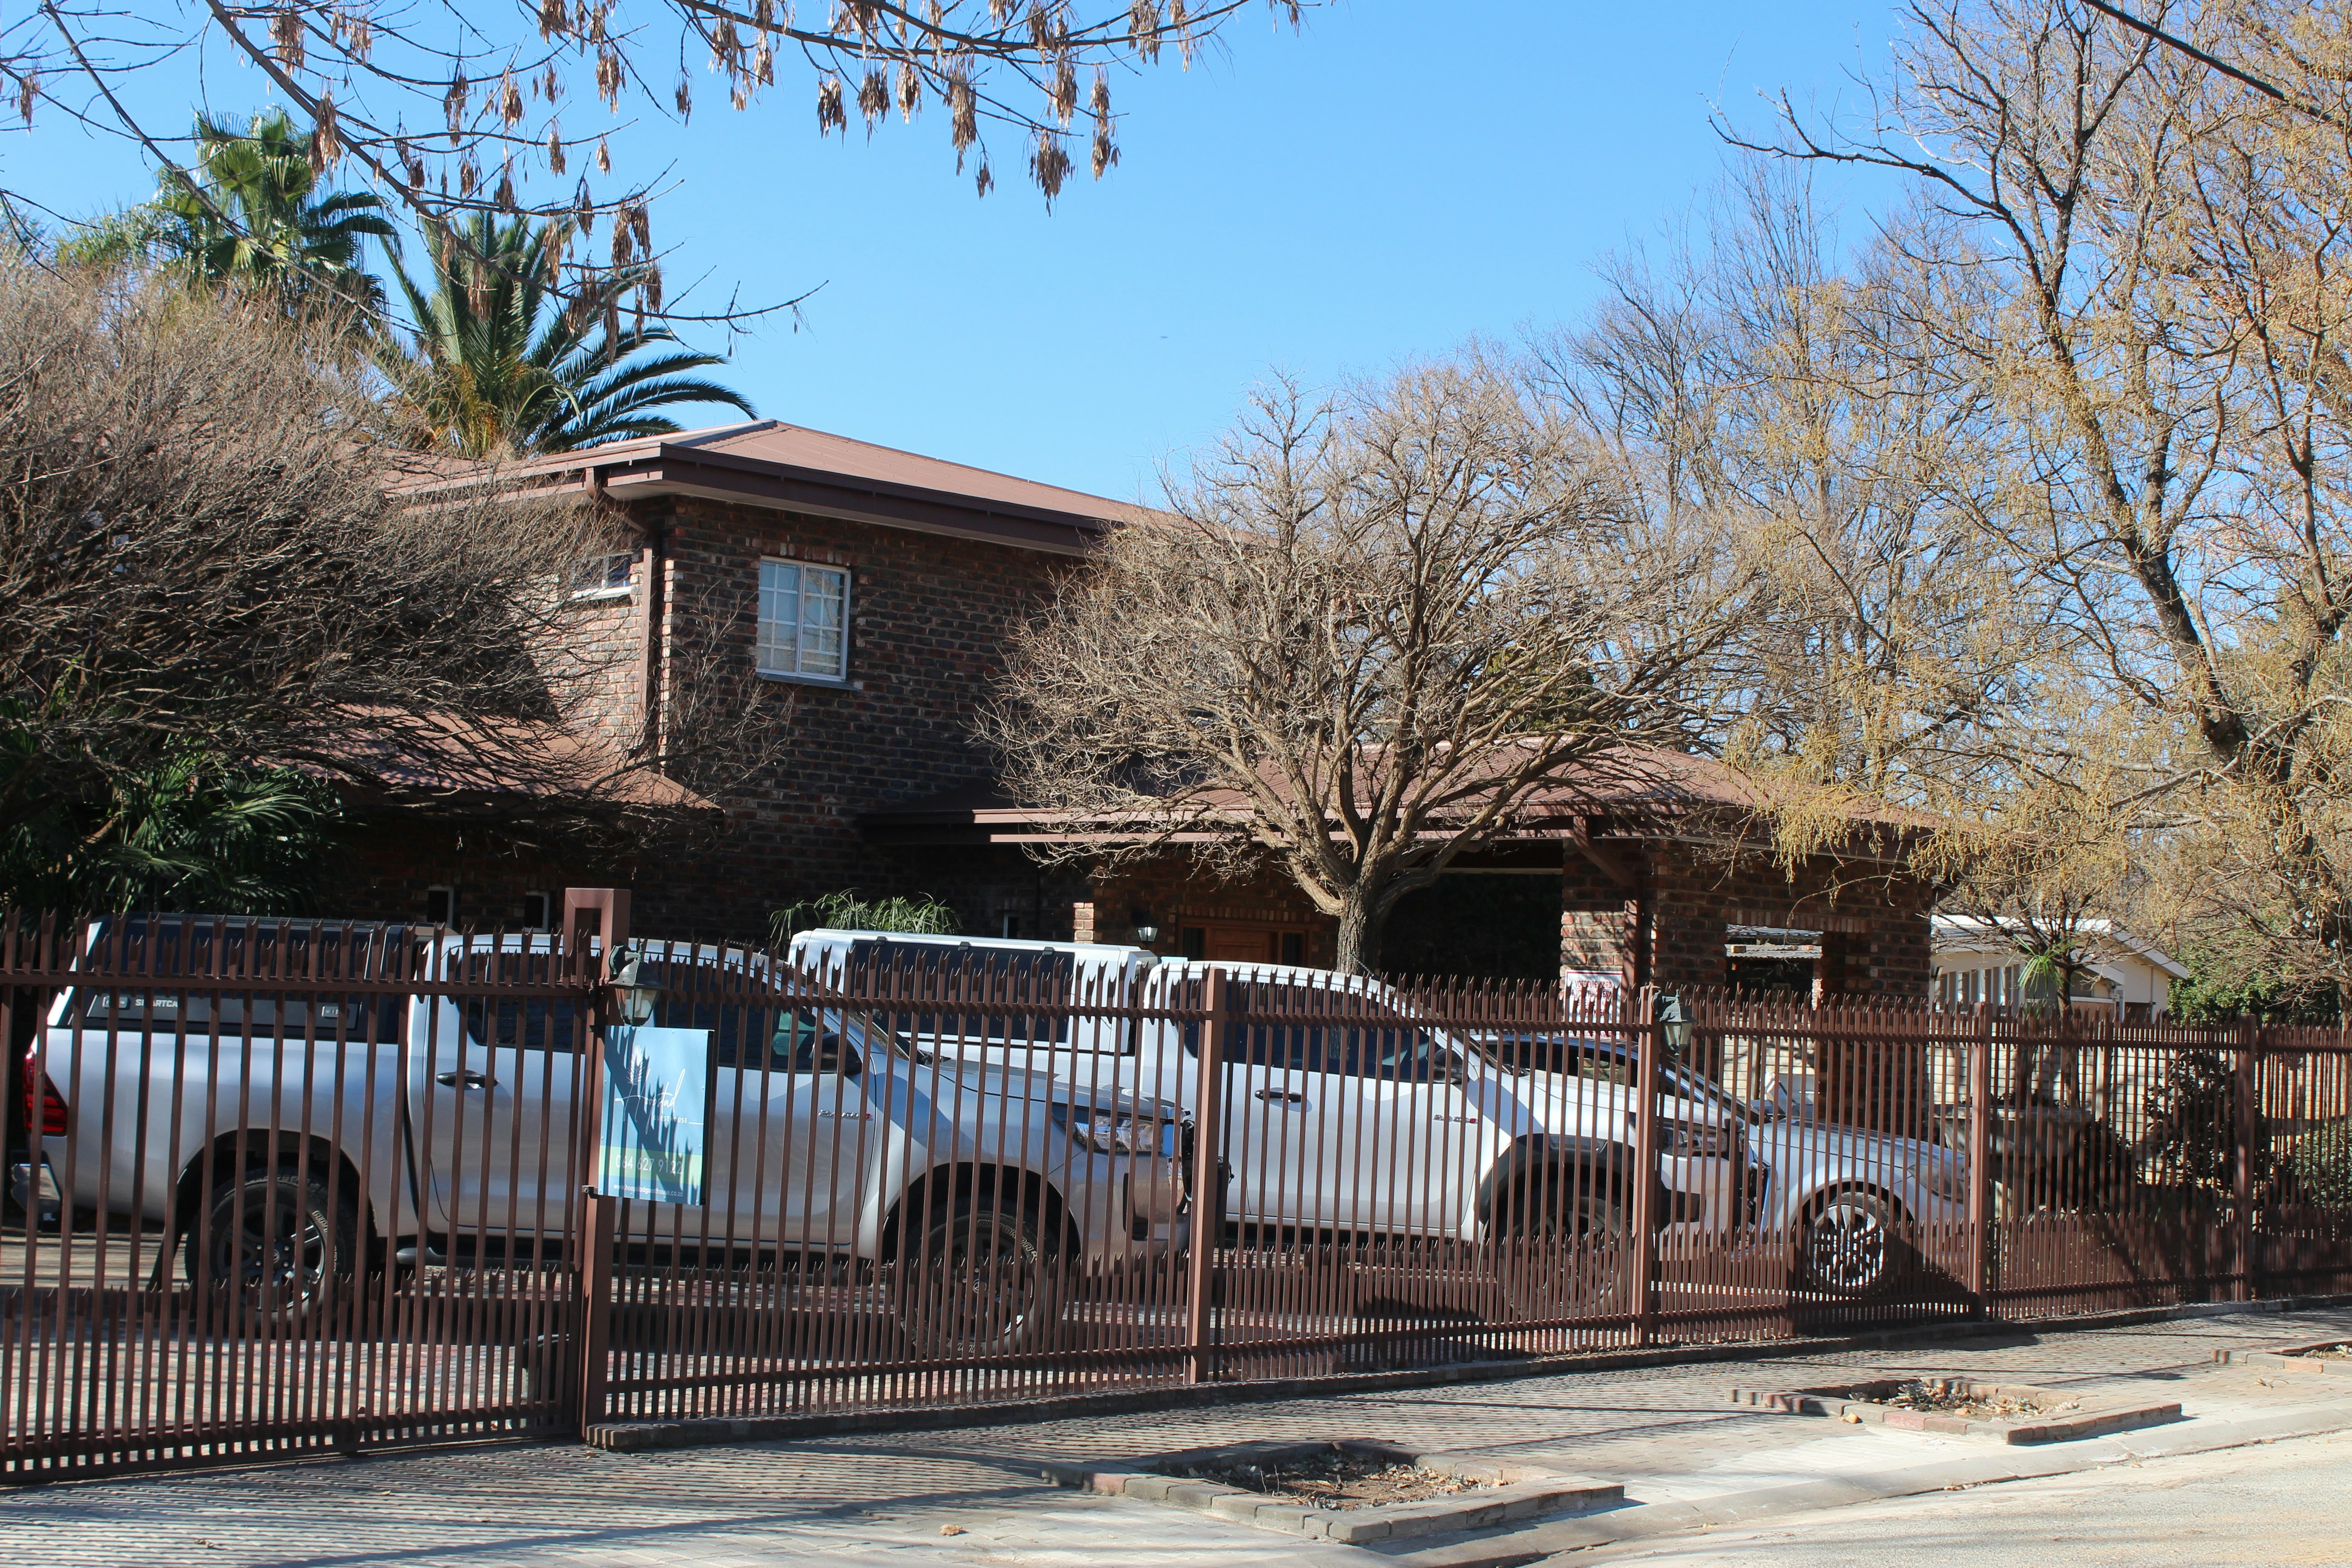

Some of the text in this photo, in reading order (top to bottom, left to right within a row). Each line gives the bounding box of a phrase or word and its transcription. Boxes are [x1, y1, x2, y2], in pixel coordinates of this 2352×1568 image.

[135, 999, 178, 1008] SRTCA
[615, 1068, 686, 1135] Hoopstad
[615, 1154, 682, 1175] 064 627 9122
[613, 1184, 683, 1197] www.hoopstadguesthouse.co.za
